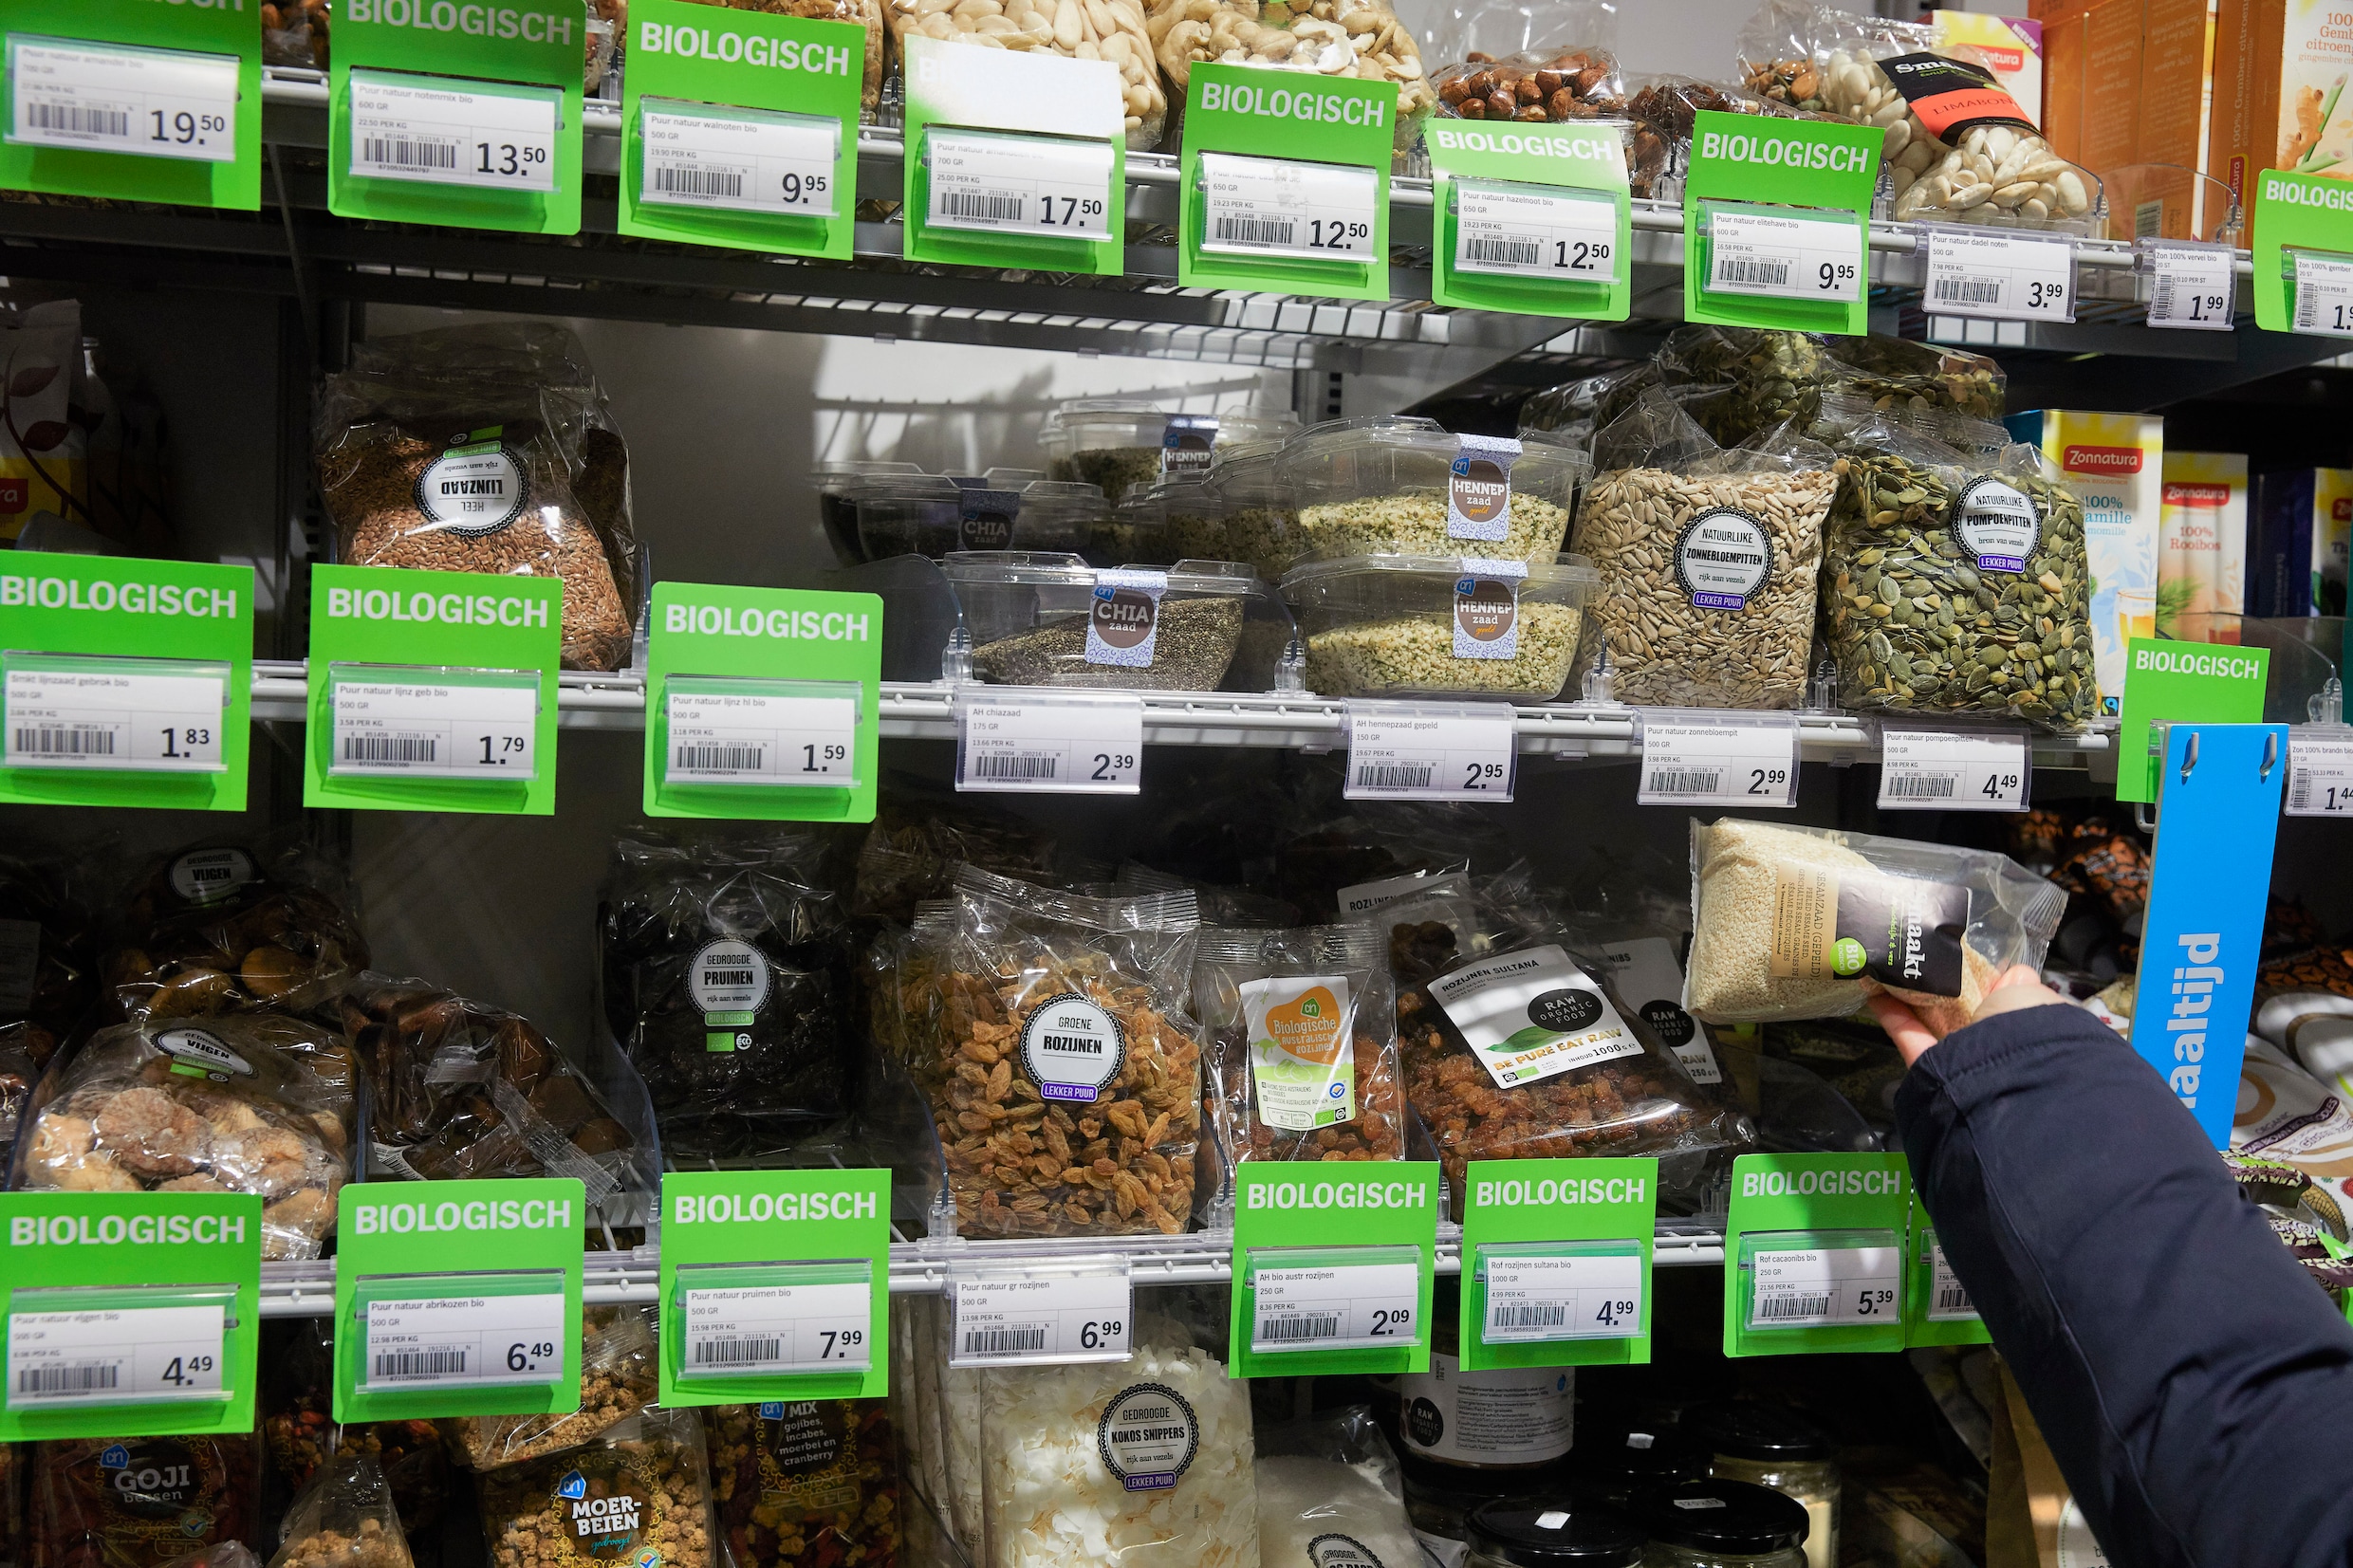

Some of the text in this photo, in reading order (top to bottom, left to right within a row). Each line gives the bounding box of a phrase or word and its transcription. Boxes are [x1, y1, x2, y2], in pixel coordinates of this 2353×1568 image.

[348, 0, 570, 45] BIOLOGISCH
[640, 21, 848, 76] BIOLOGISCH
[1201, 83, 1384, 127] BIOLOGISCH
[652, 117, 757, 133] Puur natuur walnoten bio
[1436, 130, 1614, 160] BIOLOGISCH
[1702, 133, 1868, 173] BIOLOGISCH
[1482, 193, 1504, 202] natuur
[1507, 195, 1540, 205] hazelnoot
[2069, 451, 2138, 467] Zonnatura
[441, 480, 503, 494] LIJNZAAD
[1454, 481, 1505, 496] HENNEP
[2167, 486, 2226, 500] Zonnatura
[461, 502, 484, 511] HEEL
[1467, 497, 1491, 506] zaad
[1975, 496, 2022, 507] NATUURLIJKE
[1967, 513, 2030, 528] POMPOENPITTEN
[964, 522, 1007, 536] CHIA
[1702, 528, 1752, 544] NATUURLIJKE
[2170, 539, 2221, 551] Rooibos
[1687, 547, 1763, 565] ZONNEBLOEMPITTEN
[1981, 556, 2022, 570] LEKKER PUUR
[0, 576, 236, 618] BIOLOGISCH
[1696, 594, 1741, 607] LEKKER PUUR
[328, 588, 547, 628] BIOLOGISCH
[1097, 602, 1149, 622] CHIA
[1460, 600, 1512, 614] HENNEP
[666, 604, 868, 641] BIOLOGISCH
[1108, 621, 1137, 632] zaad
[1473, 615, 1498, 624] zaad
[2136, 650, 2259, 679] BIOLOGISCH
[341, 686, 361, 694] Puur
[396, 688, 412, 697] lijnz
[415, 689, 432, 697] geb
[986, 709, 1021, 717] chiazaad
[1368, 721, 1412, 729] hennepzaad
[707, 954, 750, 965] GEDROOGDE
[1845, 944, 1860, 970] BIO
[705, 970, 752, 985] PRUIMEN
[1442, 968, 1491, 992] ROZIJNEN
[1492, 960, 1539, 975] SULTANA
[1545, 995, 1576, 1010] RAW
[709, 1014, 750, 1023] BIOLOGISCH
[1540, 1001, 1593, 1021] ORGANIC
[1556, 1009, 1586, 1024] FOOD
[1059, 1017, 1092, 1029] GROENE
[1273, 1017, 1336, 1034] Biologische
[2166, 933, 2224, 1108] aaltijd
[1044, 1036, 1102, 1054] ROZIJNEN
[1493, 1027, 1621, 1071] BE PURE EAT RAW
[1045, 1085, 1094, 1098] LEKKER PUUR
[1742, 1170, 1900, 1197] BIOLOGISCH
[1248, 1182, 1426, 1209] BIOLOGISCH
[1476, 1178, 1645, 1207] BIOLOGISCH
[676, 1191, 876, 1224] BIOLOGISCH
[356, 1200, 570, 1234] BIOLOGISCH
[10, 1215, 245, 1245] BIOLOGISCH
[1505, 1262, 1532, 1270] rozijnen
[1772, 1254, 1805, 1263] cacaonibs
[1306, 1271, 1334, 1281] rozijnen
[1020, 1281, 1049, 1290] rozijnen
[742, 1290, 776, 1300] pruimen
[426, 1300, 468, 1308] abrikozen
[789, 1401, 817, 1418] MIX
[1123, 1407, 1170, 1420] GEDROOGDE
[784, 1418, 823, 1432] gojibes,
[787, 1430, 826, 1442] incabes,
[1112, 1427, 1184, 1443] KOKOS SNIPPERS
[779, 1438, 836, 1455] moerbei en
[784, 1450, 834, 1466] cranberry
[1126, 1455, 1138, 1464] rijk
[115, 1465, 190, 1492] GOJI
[1128, 1476, 1173, 1487] LEKKER PUUR
[123, 1490, 182, 1503] bessen
[572, 1495, 642, 1520] MOER-
[577, 1511, 639, 1537] BEIEN
[592, 1532, 633, 1555] gedroogd
